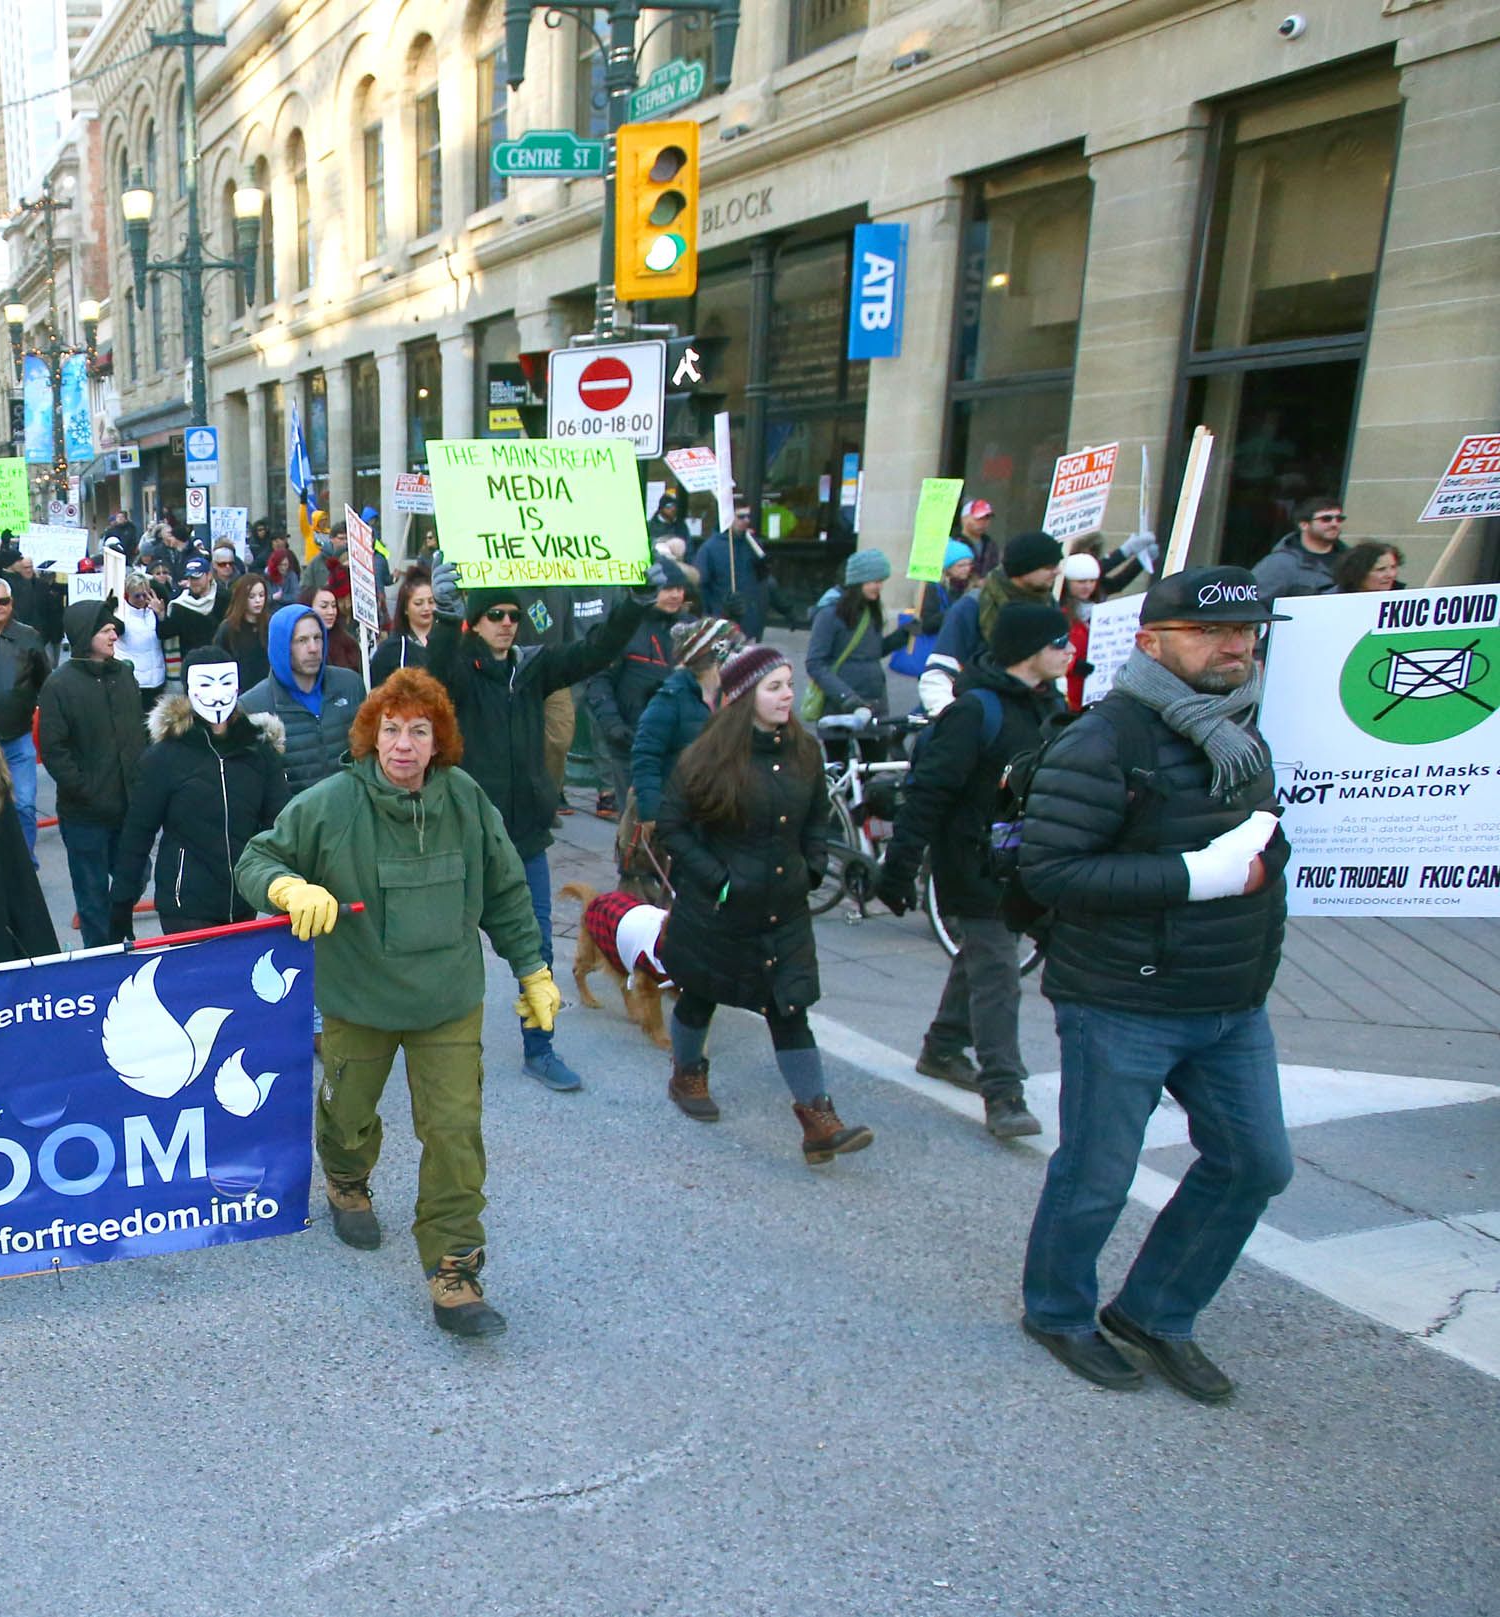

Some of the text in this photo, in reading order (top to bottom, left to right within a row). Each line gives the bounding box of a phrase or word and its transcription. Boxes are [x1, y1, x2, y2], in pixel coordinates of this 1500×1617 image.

[636, 81, 676, 116] STEPHEN
[679, 69, 697, 96] AVE
[506, 147, 591, 168] CENTRE ST
[701, 186, 774, 235] BLOCK
[860, 251, 896, 332] ATB
[557, 413, 653, 437] 06:00-18:00
[438, 445, 616, 472] THE MAINSTREAM
[1461, 440, 1500, 456] SIG
[1060, 449, 1117, 476] SIGN THE
[1454, 456, 1500, 473] PETI
[486, 475, 573, 502] MEDIA
[1055, 467, 1111, 495] PETITION
[518, 506, 544, 531] IS
[476, 534, 612, 560] THE VIRUS
[455, 563, 493, 584] TOP
[498, 560, 576, 583] SPREADING
[582, 560, 603, 578] THE
[1377, 594, 1498, 629] FKUC COVID
[1293, 763, 1492, 783] Non-surgical Masks
[1277, 784, 1471, 805] NOT MANDATORY
[1296, 865, 1500, 889] FKUC TRUDEAU FKUC CAN
[1311, 897, 1461, 905] BONNIEDOONCENTRE.COM
